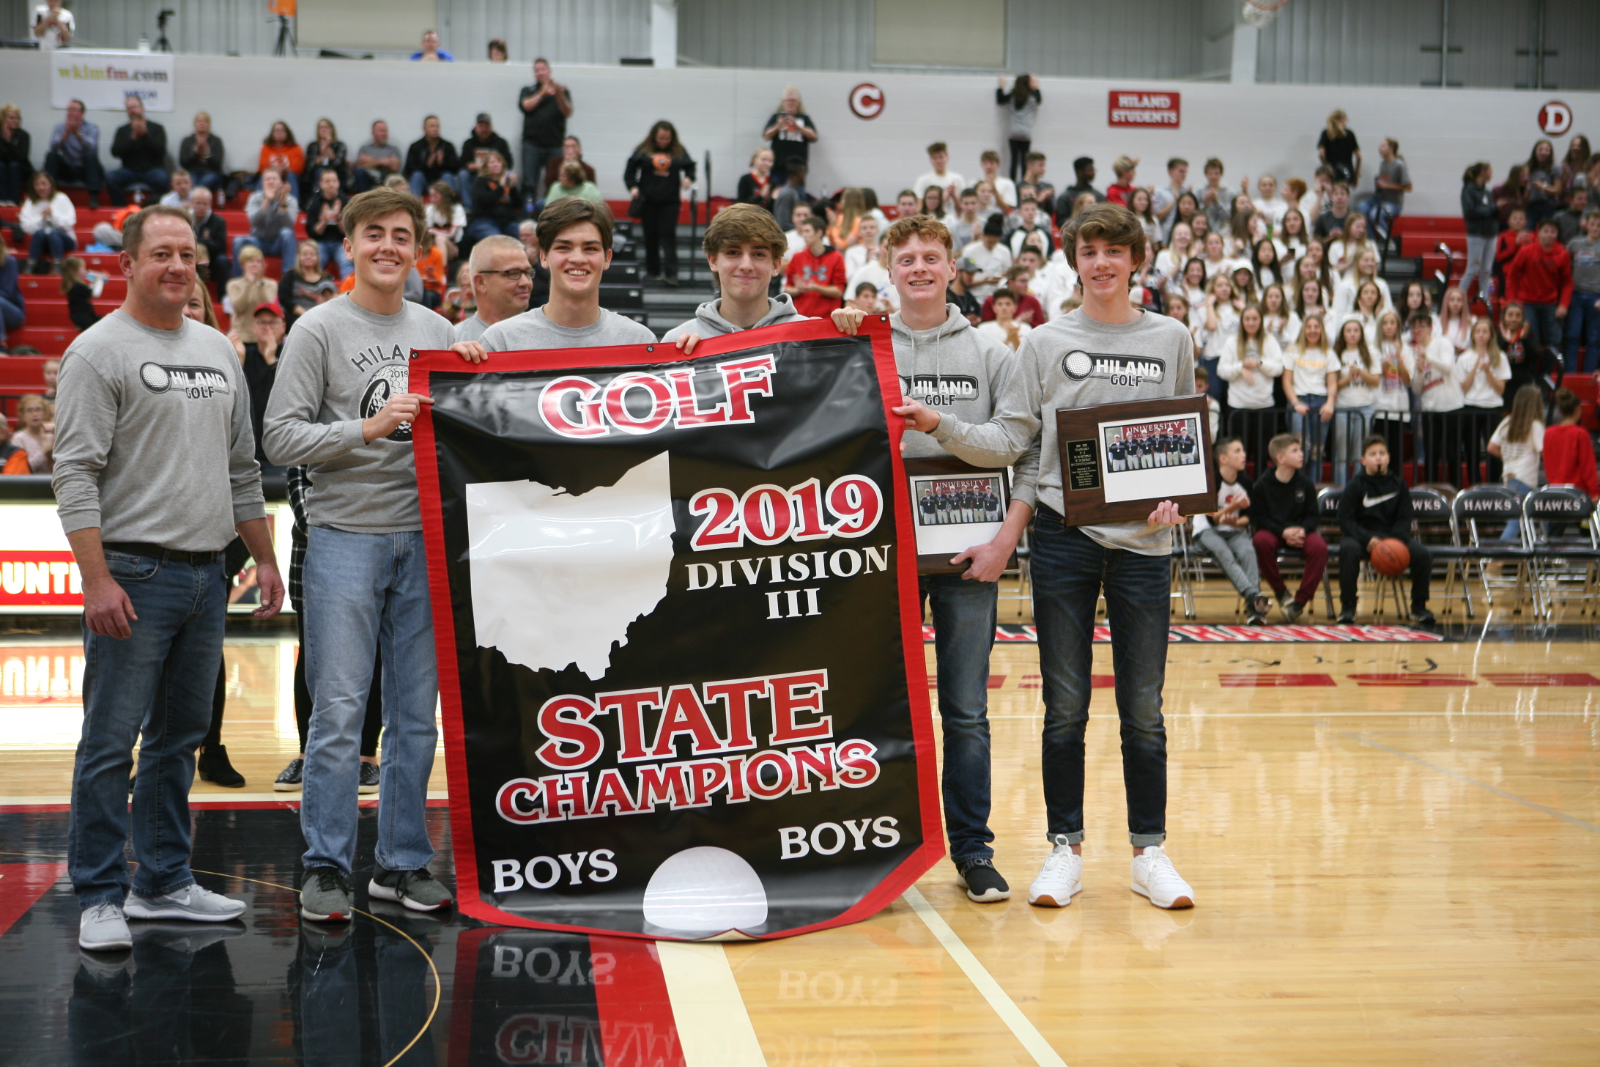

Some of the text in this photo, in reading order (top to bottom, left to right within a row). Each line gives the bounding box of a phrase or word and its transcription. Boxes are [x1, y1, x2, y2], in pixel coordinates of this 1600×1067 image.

[852, 86, 881, 117] C
[1118, 94, 1171, 109] HILAND
[1111, 109, 1177, 124] STUDENTS
[1545, 104, 1571, 133] D
[351, 344, 414, 372] HILA
[1096, 359, 1161, 378] HILAND
[170, 370, 226, 388] HILAND
[912, 380, 974, 395] HILAND
[1110, 374, 1143, 387] GOLF
[185, 386, 214, 399] GOLF
[538, 354, 776, 439] GOLF
[925, 394, 956, 406] GOLF
[1126, 421, 1181, 435] UNIVERSITY
[689, 475, 883, 551] 2019
[1464, 499, 1512, 511] HAWKS
[1533, 499, 1581, 511] HAWKS
[685, 545, 891, 591] DIVISION
[764, 588, 823, 620] III
[535, 668, 833, 769] STATE
[496, 738, 880, 825] CHAMPIONS
[778, 815, 900, 860] BOYS
[491, 849, 618, 893] BOYS
